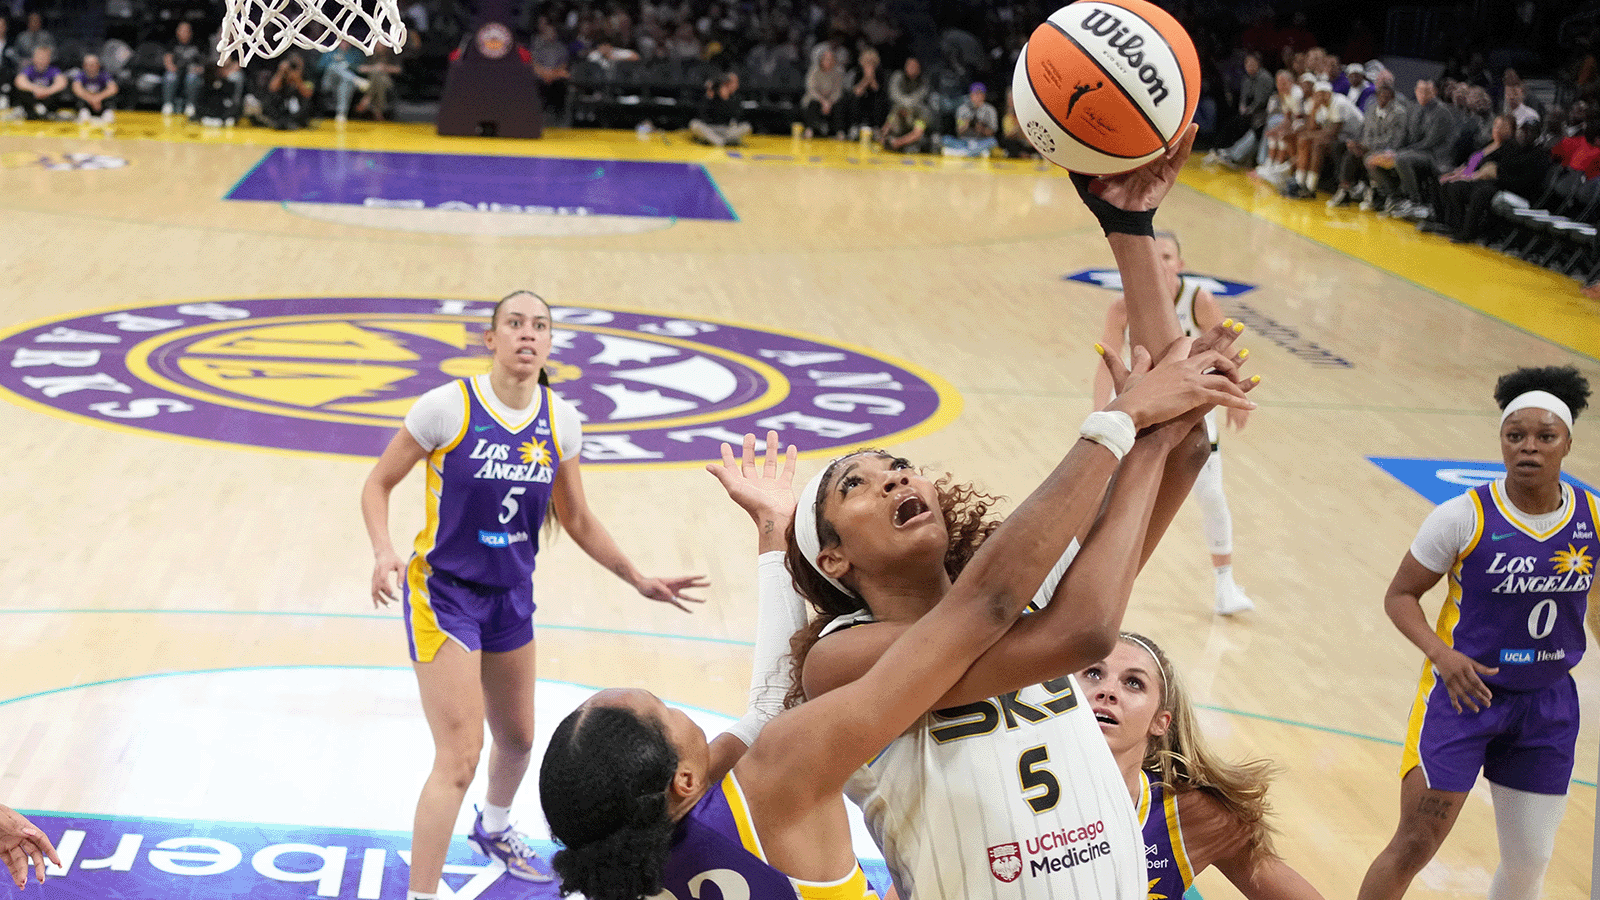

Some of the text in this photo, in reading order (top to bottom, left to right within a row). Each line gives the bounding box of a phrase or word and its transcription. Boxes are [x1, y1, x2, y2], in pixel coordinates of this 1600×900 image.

[1080, 8, 1169, 108] Wilson
[11, 302, 250, 420] SPARKS
[469, 438, 511, 461] LOS
[473, 459, 554, 484] ANGELES
[498, 486, 527, 524] 5
[1572, 531, 1593, 539] Albert
[1485, 552, 1537, 574] LOS
[1492, 573, 1592, 594] ANGELES
[1527, 598, 1558, 640] 0
[1504, 651, 1531, 662] UCLA
[1017, 743, 1062, 816] 5
[1026, 820, 1105, 855] UChicago
[1029, 840, 1111, 877] Medicine
[1146, 858, 1169, 869] bert
